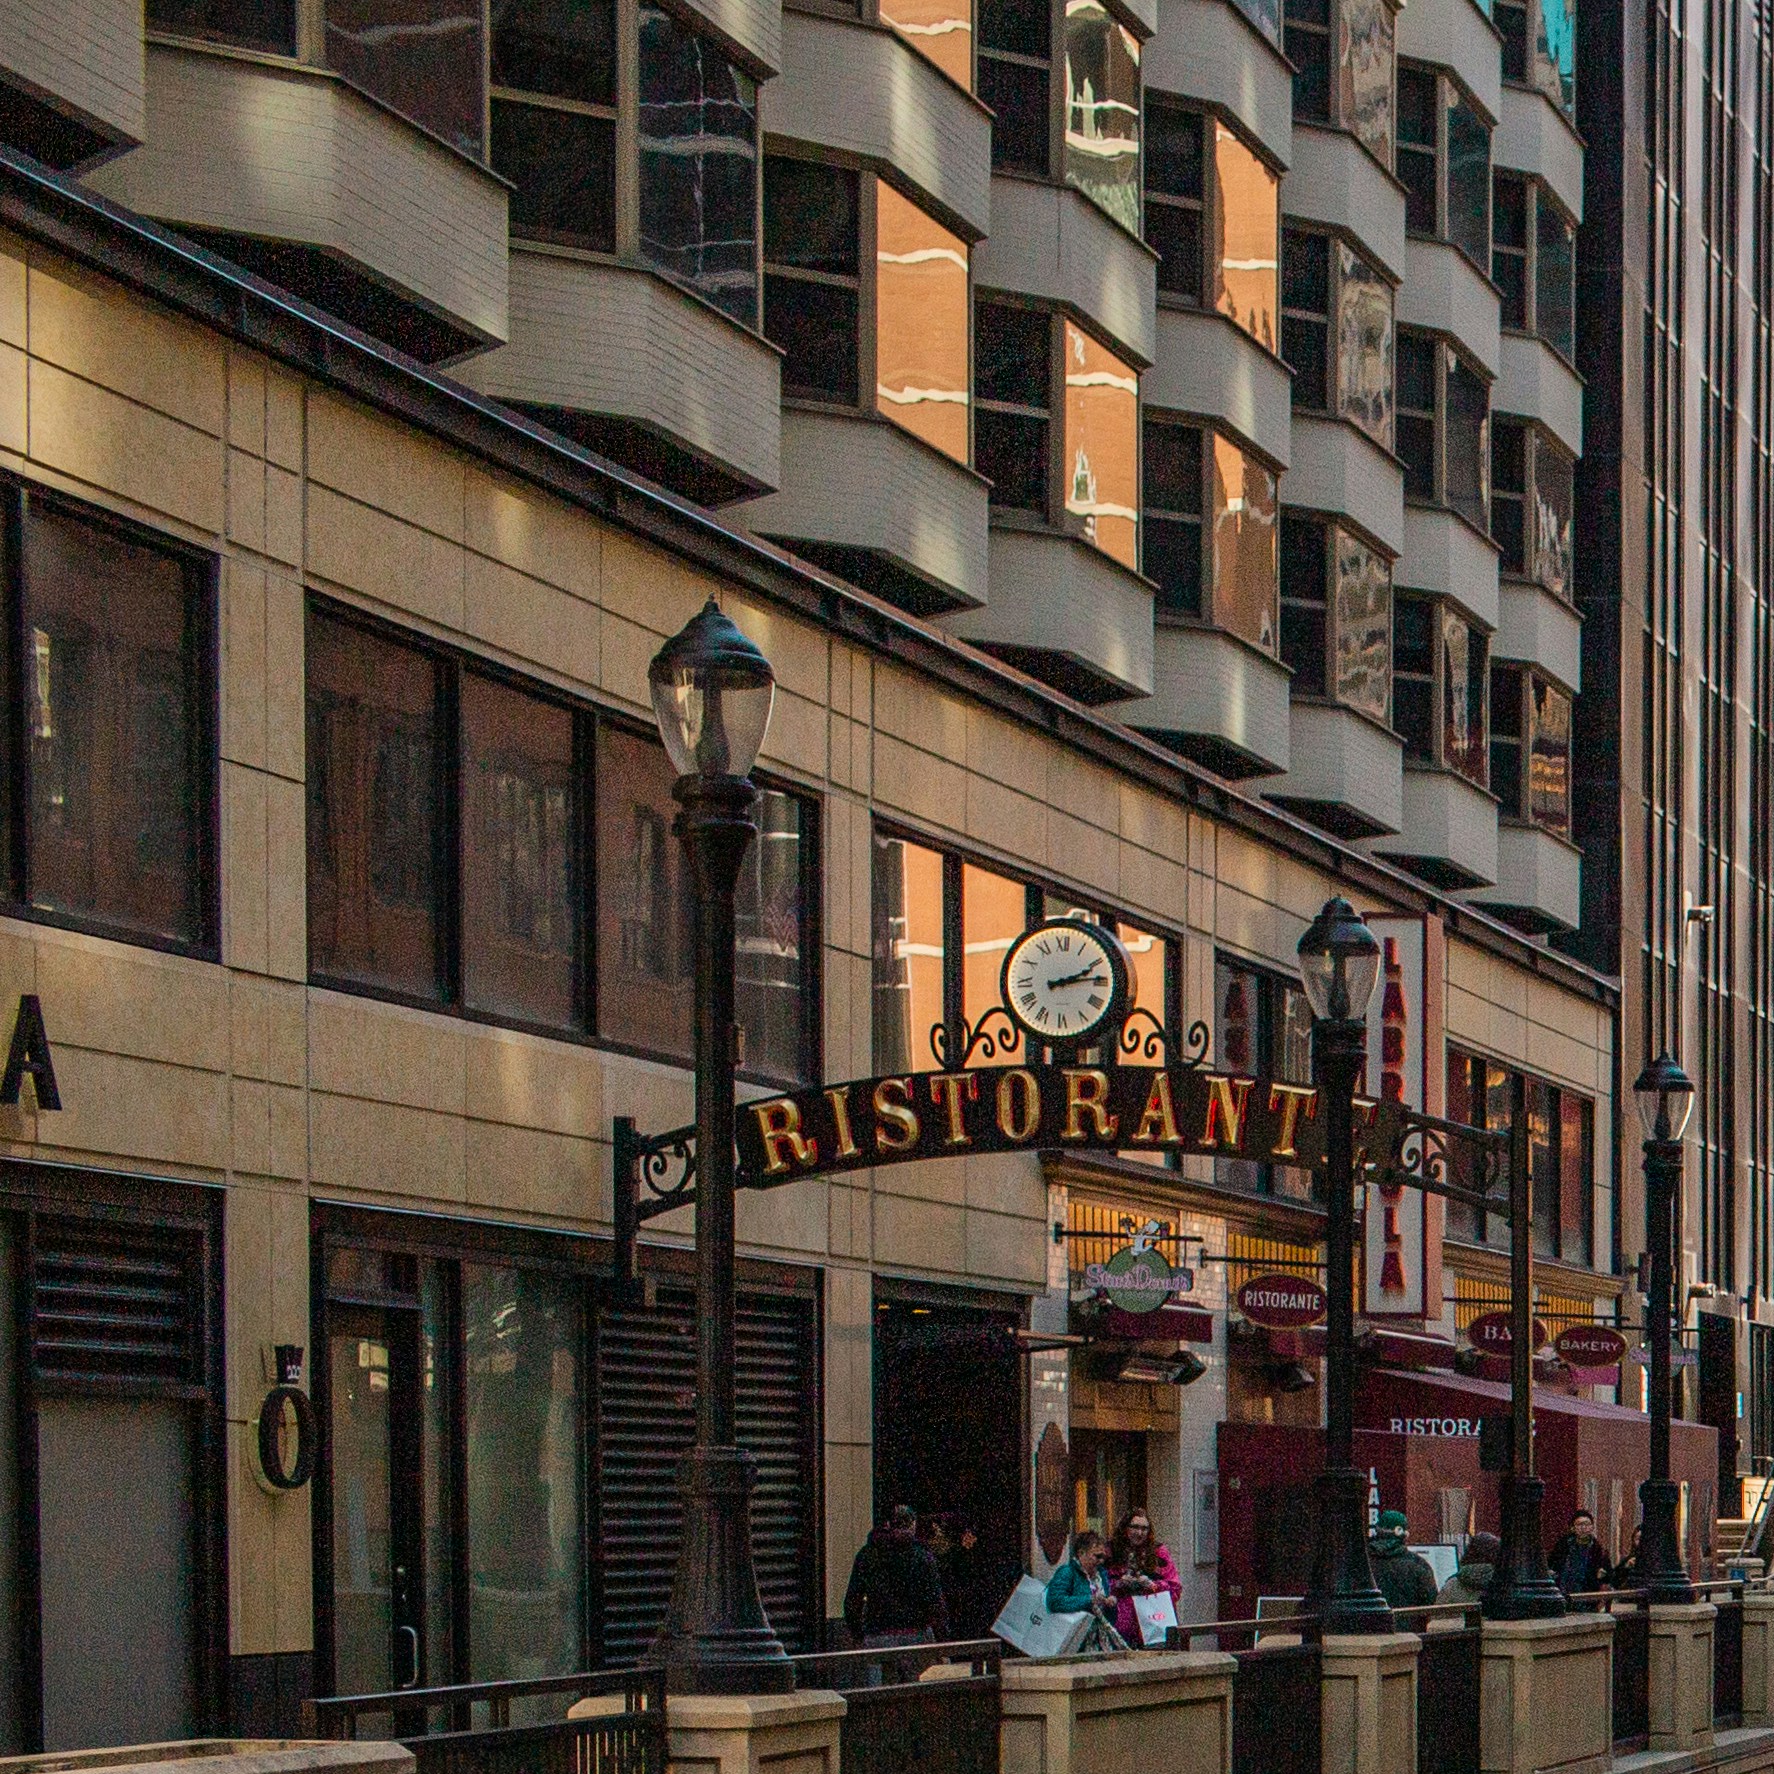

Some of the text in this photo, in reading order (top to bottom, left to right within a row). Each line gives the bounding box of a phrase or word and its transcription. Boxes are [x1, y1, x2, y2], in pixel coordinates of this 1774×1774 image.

[1379, 936, 1409, 1291] LABRLA
[1244, 1290, 1321, 1311] RISTORANTE
[1484, 1325, 1513, 1341] BA
[1560, 1339, 1621, 1352] BAKERY
